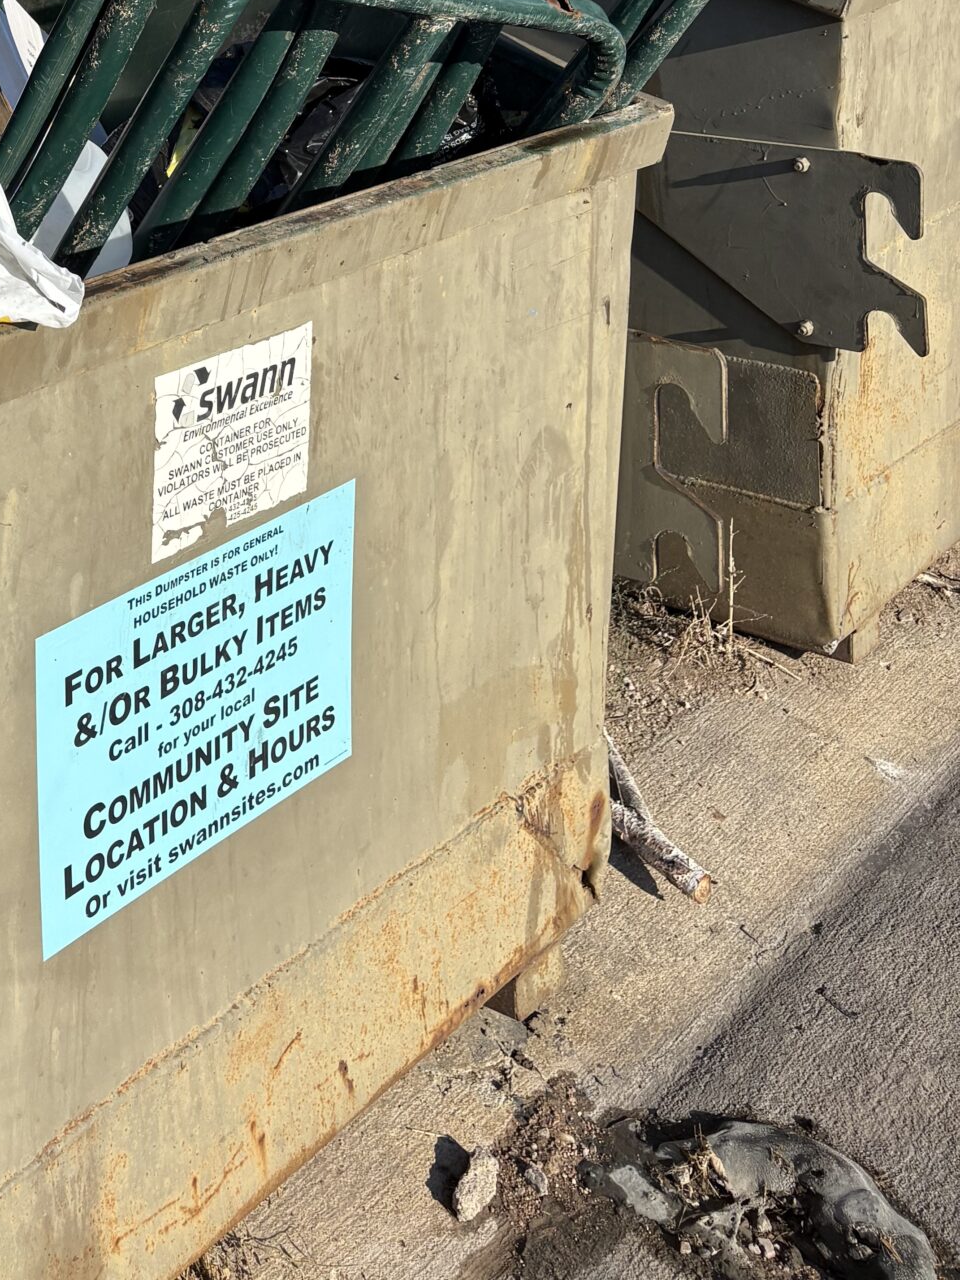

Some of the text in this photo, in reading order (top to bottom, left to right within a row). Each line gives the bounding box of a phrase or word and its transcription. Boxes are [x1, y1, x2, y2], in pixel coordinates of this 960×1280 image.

[157, 426, 307, 497] VIOLATORS WL BE PROSECUTED
[168, 458, 203, 480] SWANN
[256, 428, 274, 443] USE
[275, 417, 299, 435] ONLY
[183, 407, 248, 442] Environmental
[199, 417, 272, 455] CONTAINER FOR
[162, 506, 181, 521] ALL
[182, 489, 215, 512] WASTE
[217, 478, 241, 497] MUST
[243, 471, 256, 485] BE
[257, 456, 292, 479] PLACED
[293, 451, 302, 463] IN
[208, 482, 260, 512] CONTAINER
[127, 525, 284, 610] THIS DUMPSTER IS FOR GENERAL
[133, 544, 279, 629] HOUSEHOLD WASTE ONLY!
[64, 540, 334, 707] FOR LARGER, HEAVY
[74, 586, 327, 747] &/OR BULKY ITEMS
[108, 722, 150, 762] Call
[169, 636, 298, 727] 308-432-4245
[83, 675, 320, 839] COMMUNITY SITE
[157, 688, 255, 758] for your local
[63, 705, 336, 900] LOCATION & HOURS
[85, 753, 320, 918] Or visit swannsites.com
